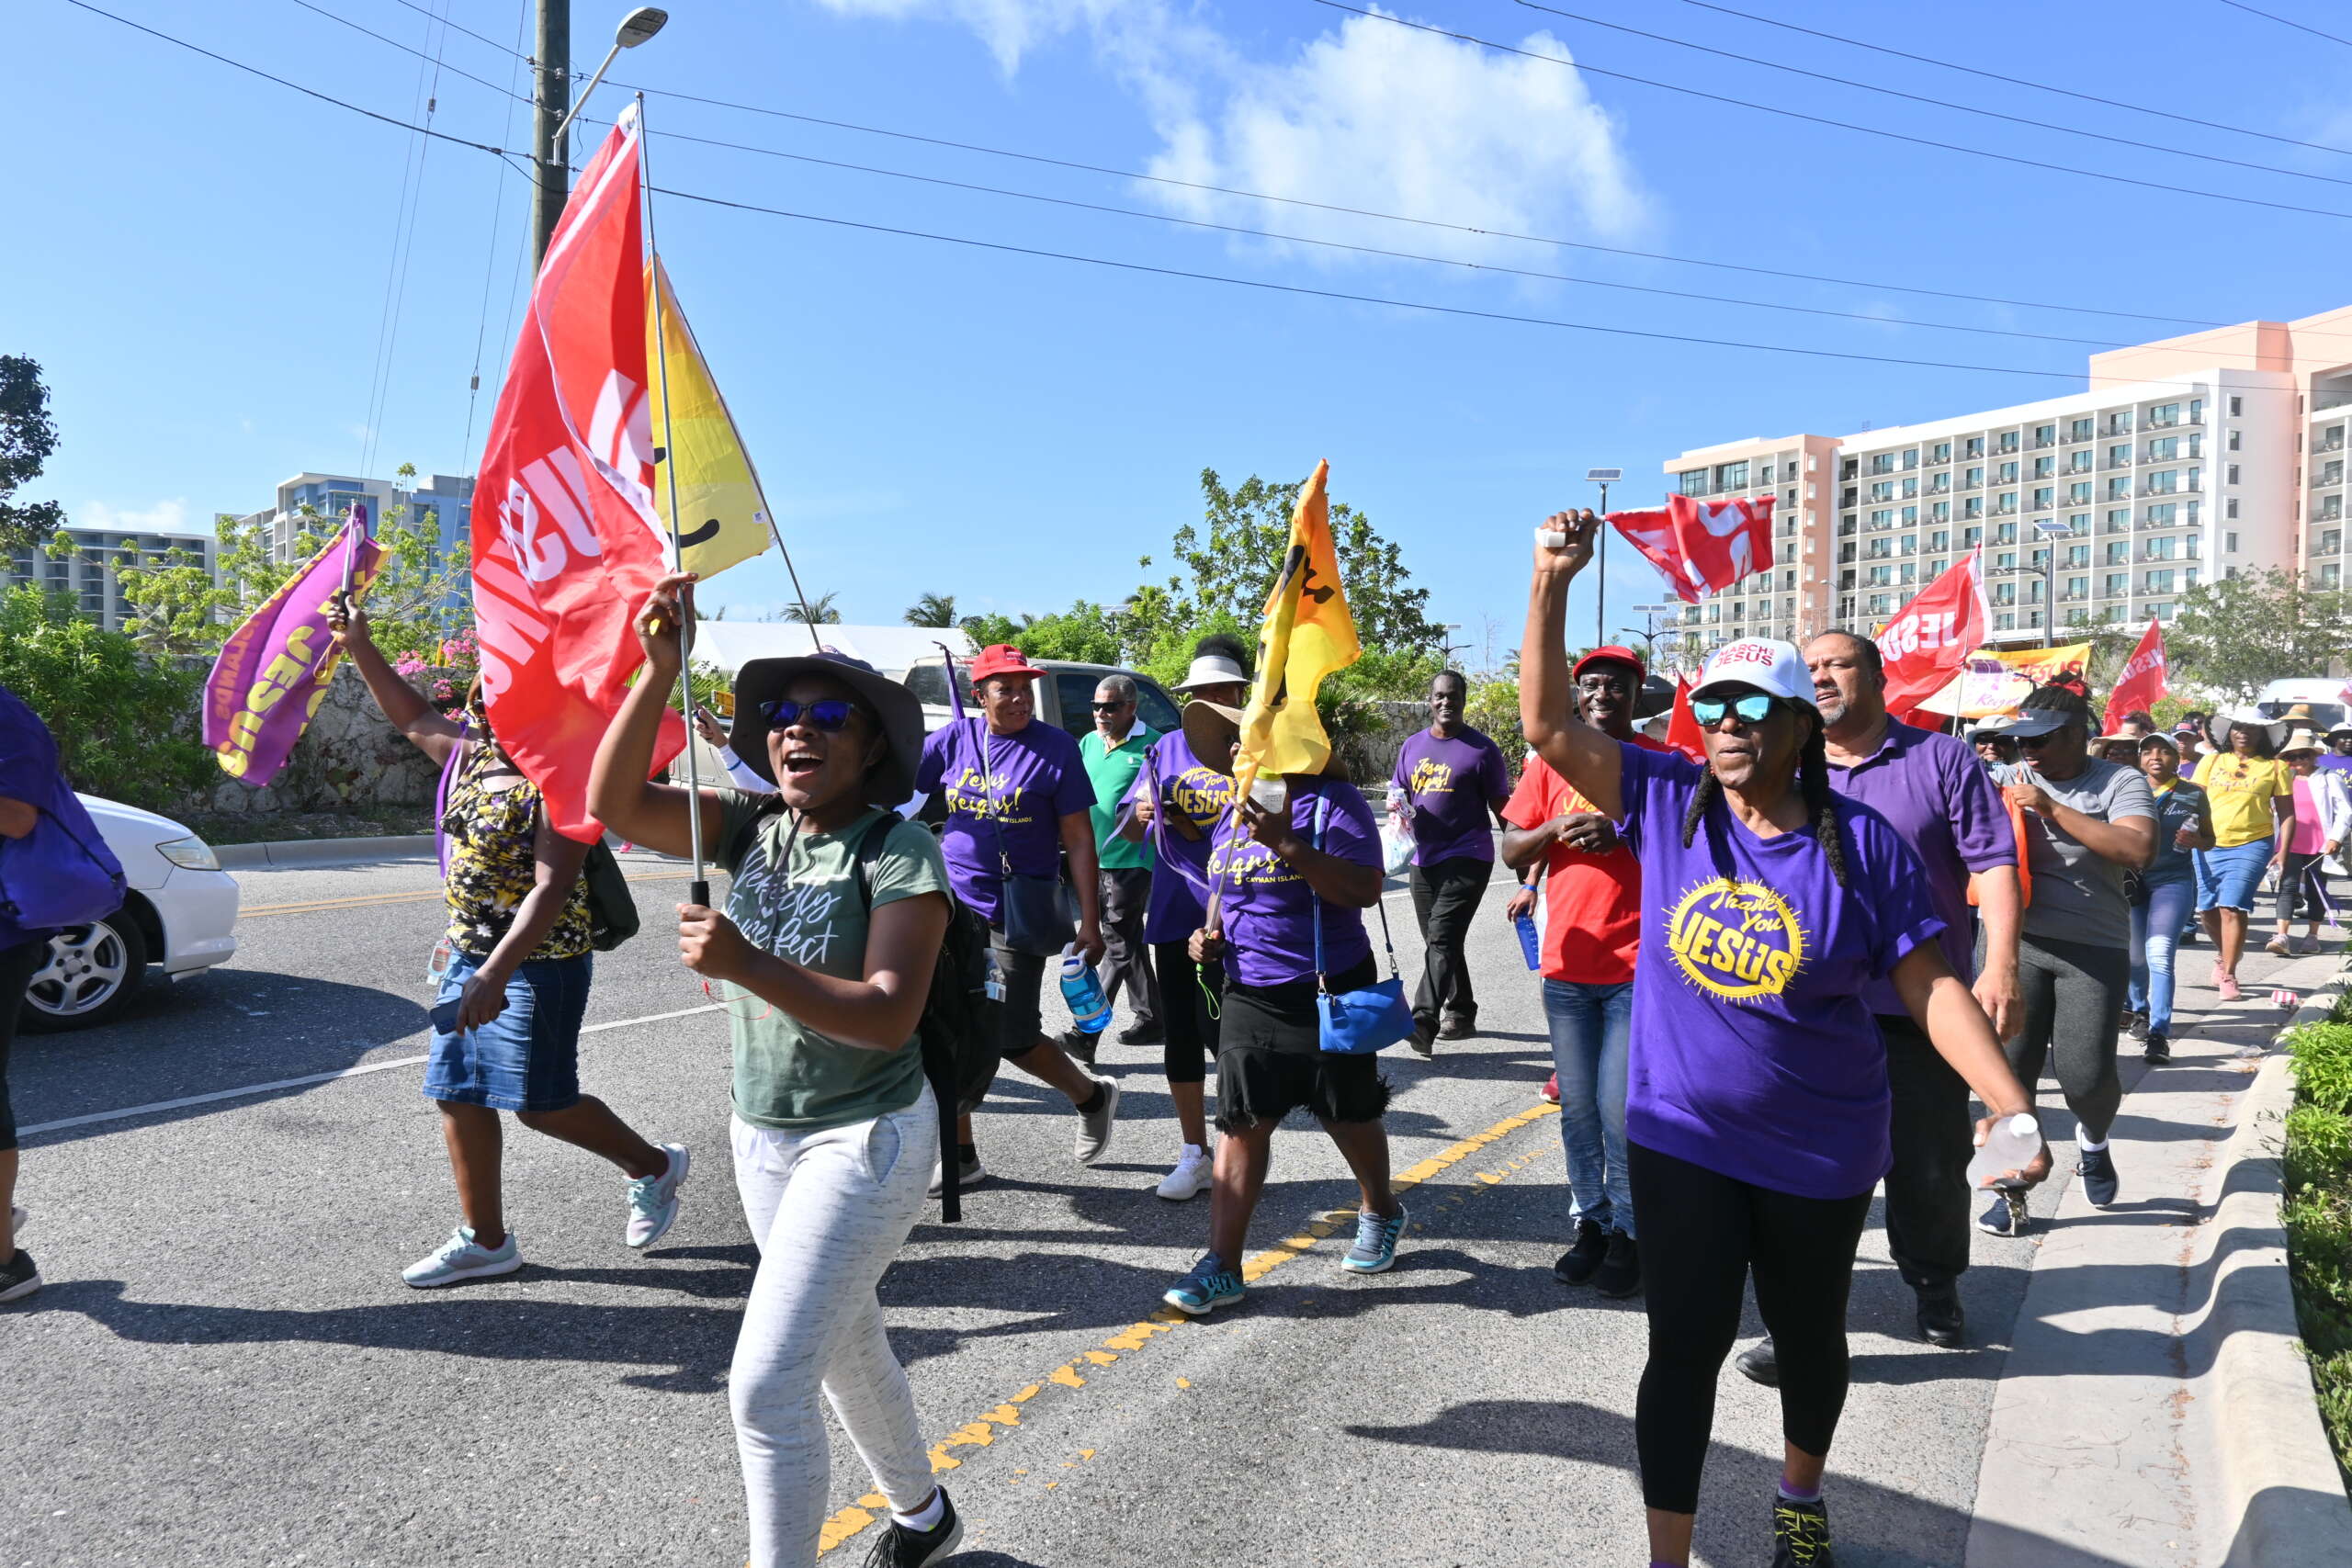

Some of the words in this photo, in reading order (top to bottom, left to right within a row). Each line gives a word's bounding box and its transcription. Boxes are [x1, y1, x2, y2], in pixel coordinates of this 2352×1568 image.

[1715, 651, 1772, 667] JESUS
[1719, 644, 1768, 657] MARCH
[1415, 758, 1449, 775] Jesus
[956, 767, 1010, 793] Jesus
[1563, 786, 1597, 813] Jes
[1278, 874, 1304, 883] ISLAN
[1710, 886, 1780, 911] Thank
[1740, 909, 1783, 933] You
[1668, 911, 1794, 994] JESUS
